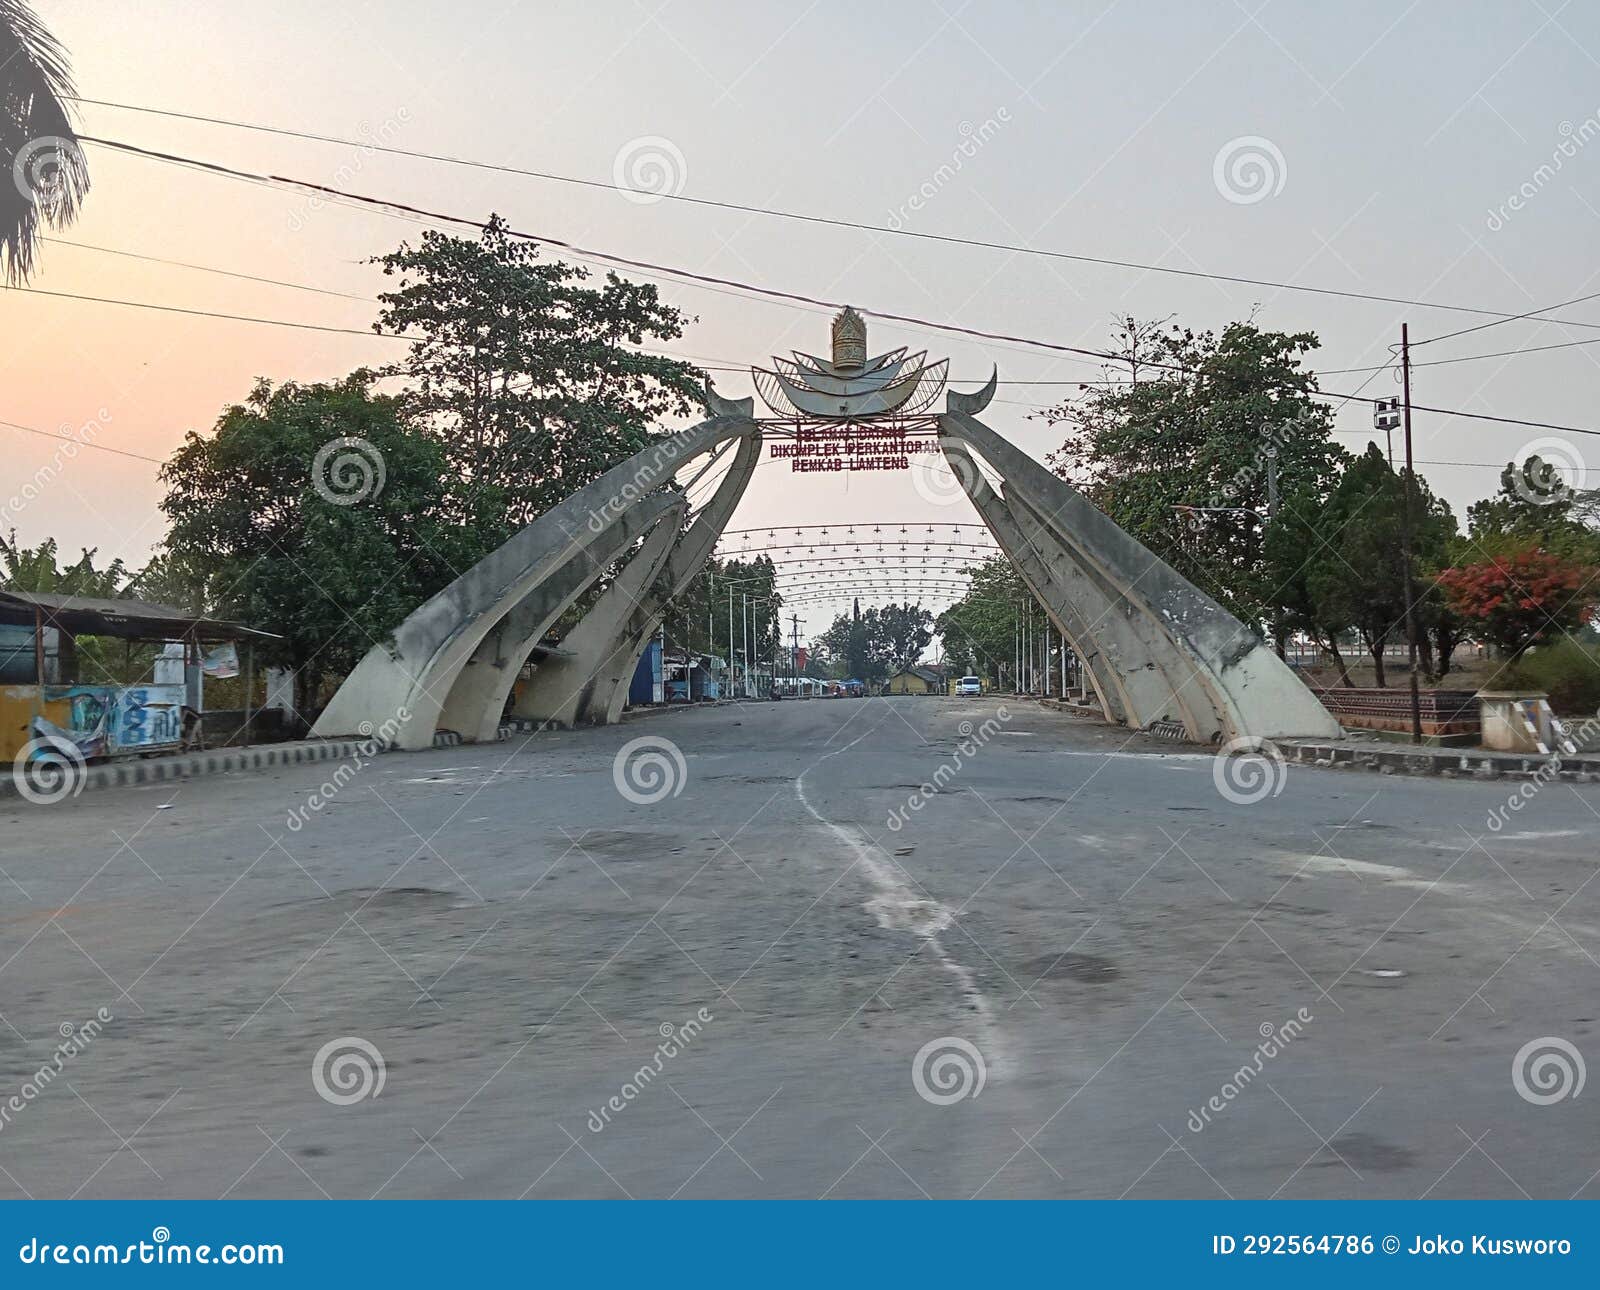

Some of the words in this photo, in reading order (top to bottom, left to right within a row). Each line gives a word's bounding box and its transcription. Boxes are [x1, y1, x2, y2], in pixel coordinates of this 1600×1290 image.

[770, 443, 840, 458] DIKOMPLEK
[792, 458, 841, 472] PEMKAB
[850, 456, 909, 471] LAMTENG
